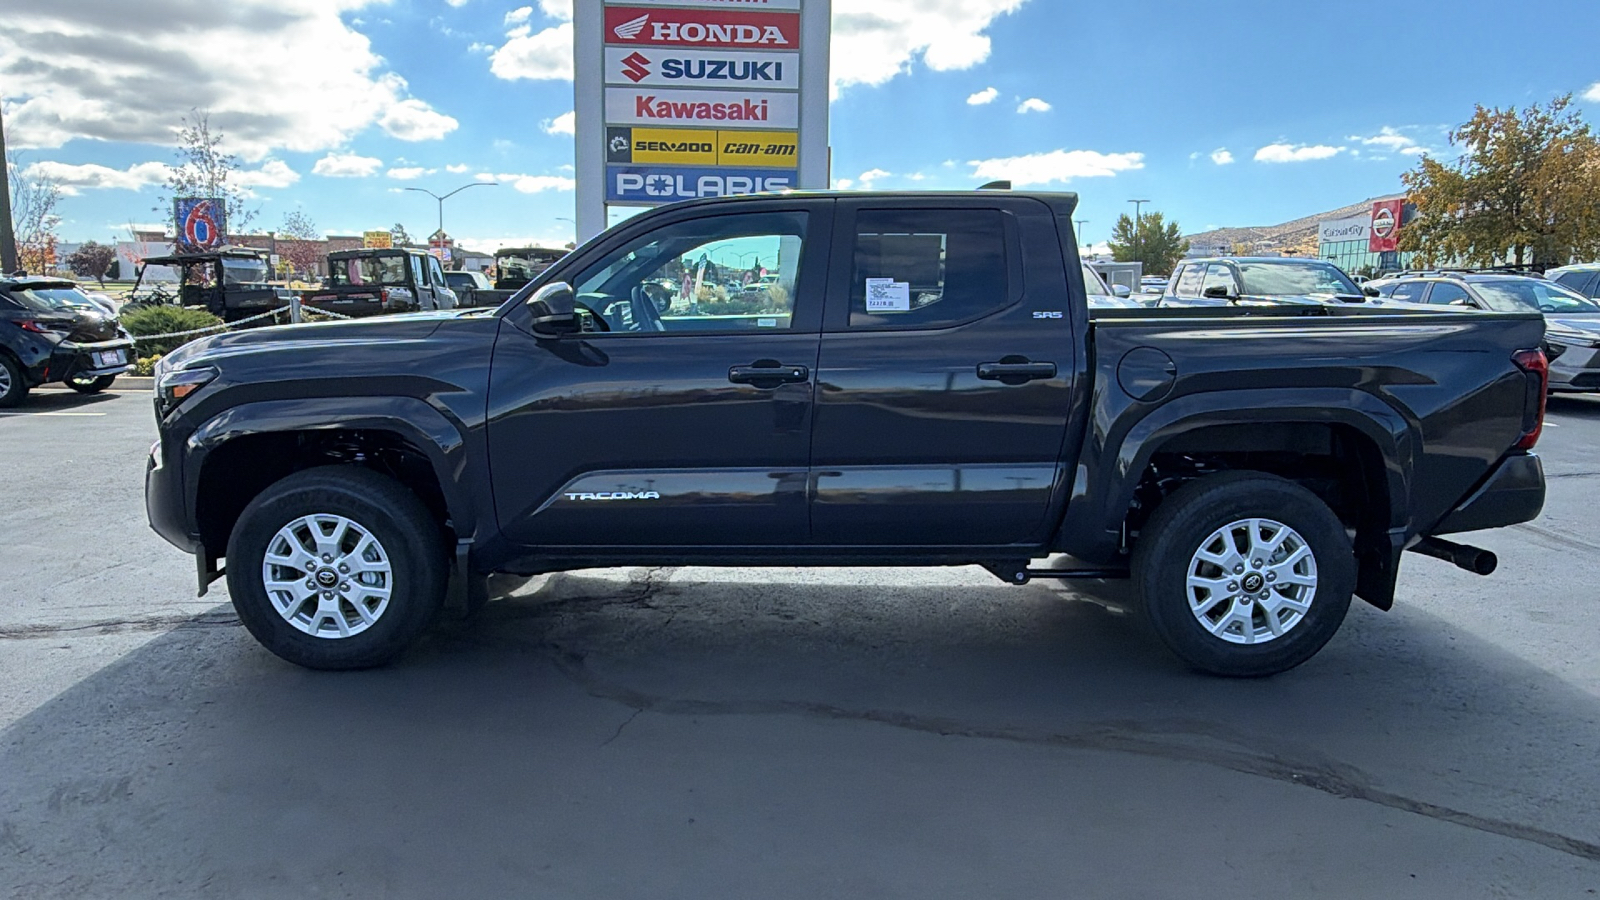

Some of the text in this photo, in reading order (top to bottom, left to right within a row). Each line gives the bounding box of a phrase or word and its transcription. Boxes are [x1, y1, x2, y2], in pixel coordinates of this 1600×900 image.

[651, 22, 789, 44] HONDA
[661, 58, 782, 81] SUZUKI
[635, 95, 768, 121] Kawasaki
[723, 142, 795, 156] can-am
[616, 173, 789, 197] POLARIS
[185, 200, 217, 248] 6
[1349, 224, 1364, 236] City
[1032, 311, 1063, 319] SR5
[564, 491, 660, 501] TACOMA
